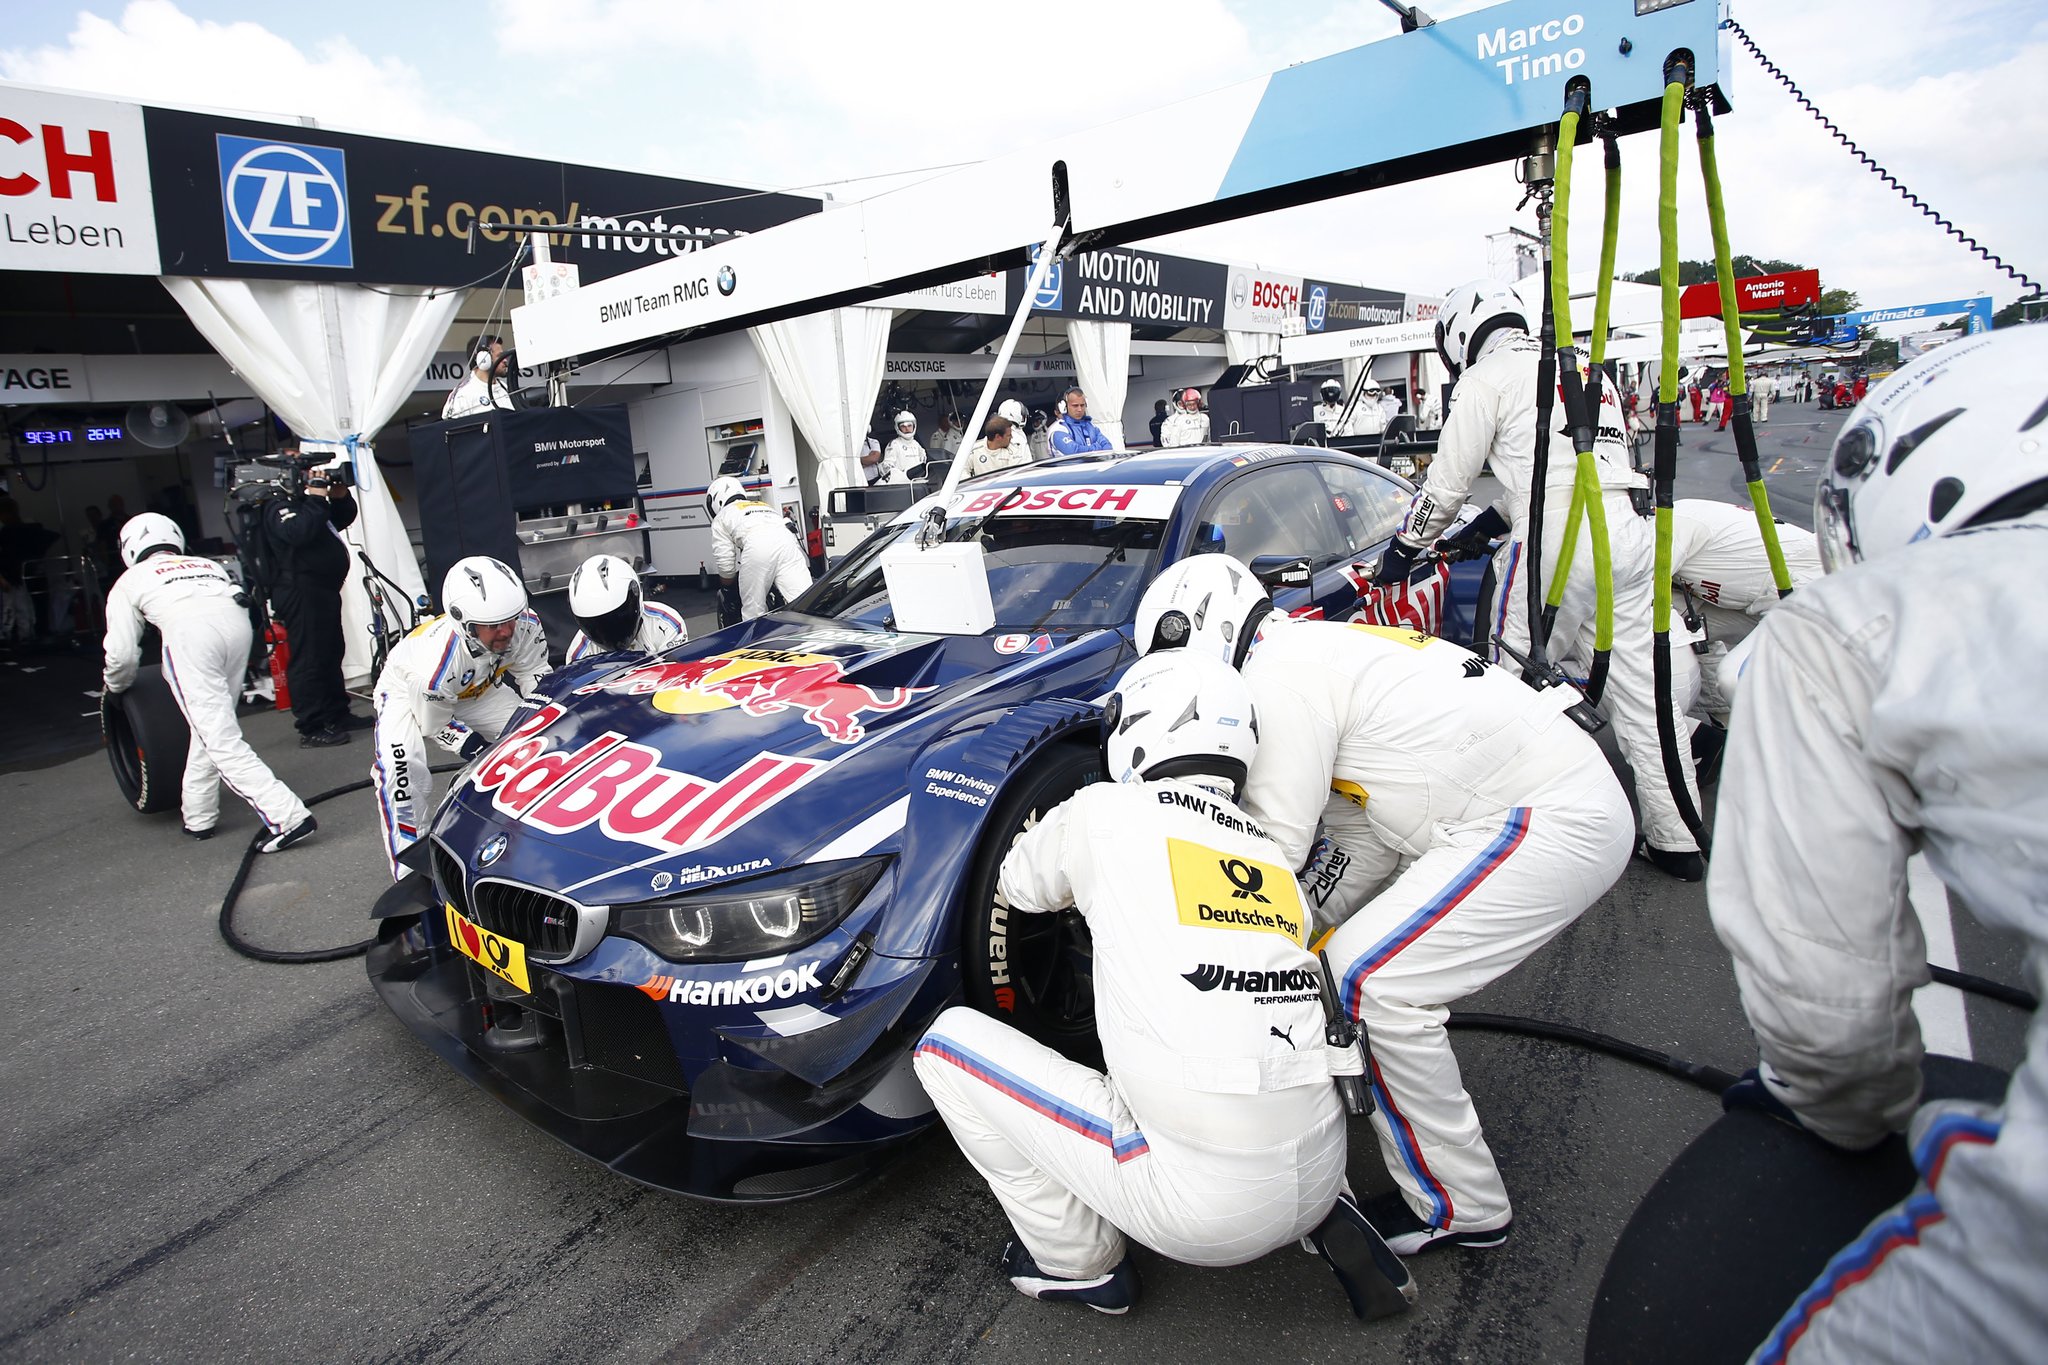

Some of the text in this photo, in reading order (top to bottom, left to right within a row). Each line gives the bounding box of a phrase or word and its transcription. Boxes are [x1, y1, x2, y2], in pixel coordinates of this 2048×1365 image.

[1477, 14, 1584, 60] Marco
[1496, 48, 1585, 86] Timo
[5, 213, 124, 248] Leben
[1078, 251, 1160, 287] MOTION
[964, 284, 997, 301] Leben
[1252, 280, 1299, 311] BOSCH
[1744, 280, 1785, 293] Antonio
[1752, 288, 1785, 300] Martin
[600, 277, 709, 323] BMW Team RMG
[1078, 284, 1214, 324] AND MOBILITY
[1861, 307, 1926, 323] ultimate
[1349, 340, 1373, 348] BMW
[1375, 335, 1399, 344] Team
[886, 360, 946, 373] BACKSTAGE
[1043, 361, 1073, 371] MARTIN
[534, 437, 606, 453] BMW Motorsport
[1242, 446, 1298, 463] WITTMANN
[961, 488, 1139, 514] BOSCH
[1281, 570, 1309, 582] PUMA
[1003, 637, 1017, 648] E
[737, 649, 806, 662] ADAC
[391, 743, 411, 802] Power
[476, 704, 818, 848] Red Bull
[925, 768, 997, 795] BMW Driving
[925, 782, 987, 807] Experience
[1157, 791, 1207, 815] BMW
[1209, 803, 1244, 833] Team
[680, 857, 772, 885] HELIX ULTRA
[681, 864, 702, 876] Shell
[1198, 903, 1299, 938] Deutsche Post
[1253, 994, 1312, 1005] PERFORMANCE
